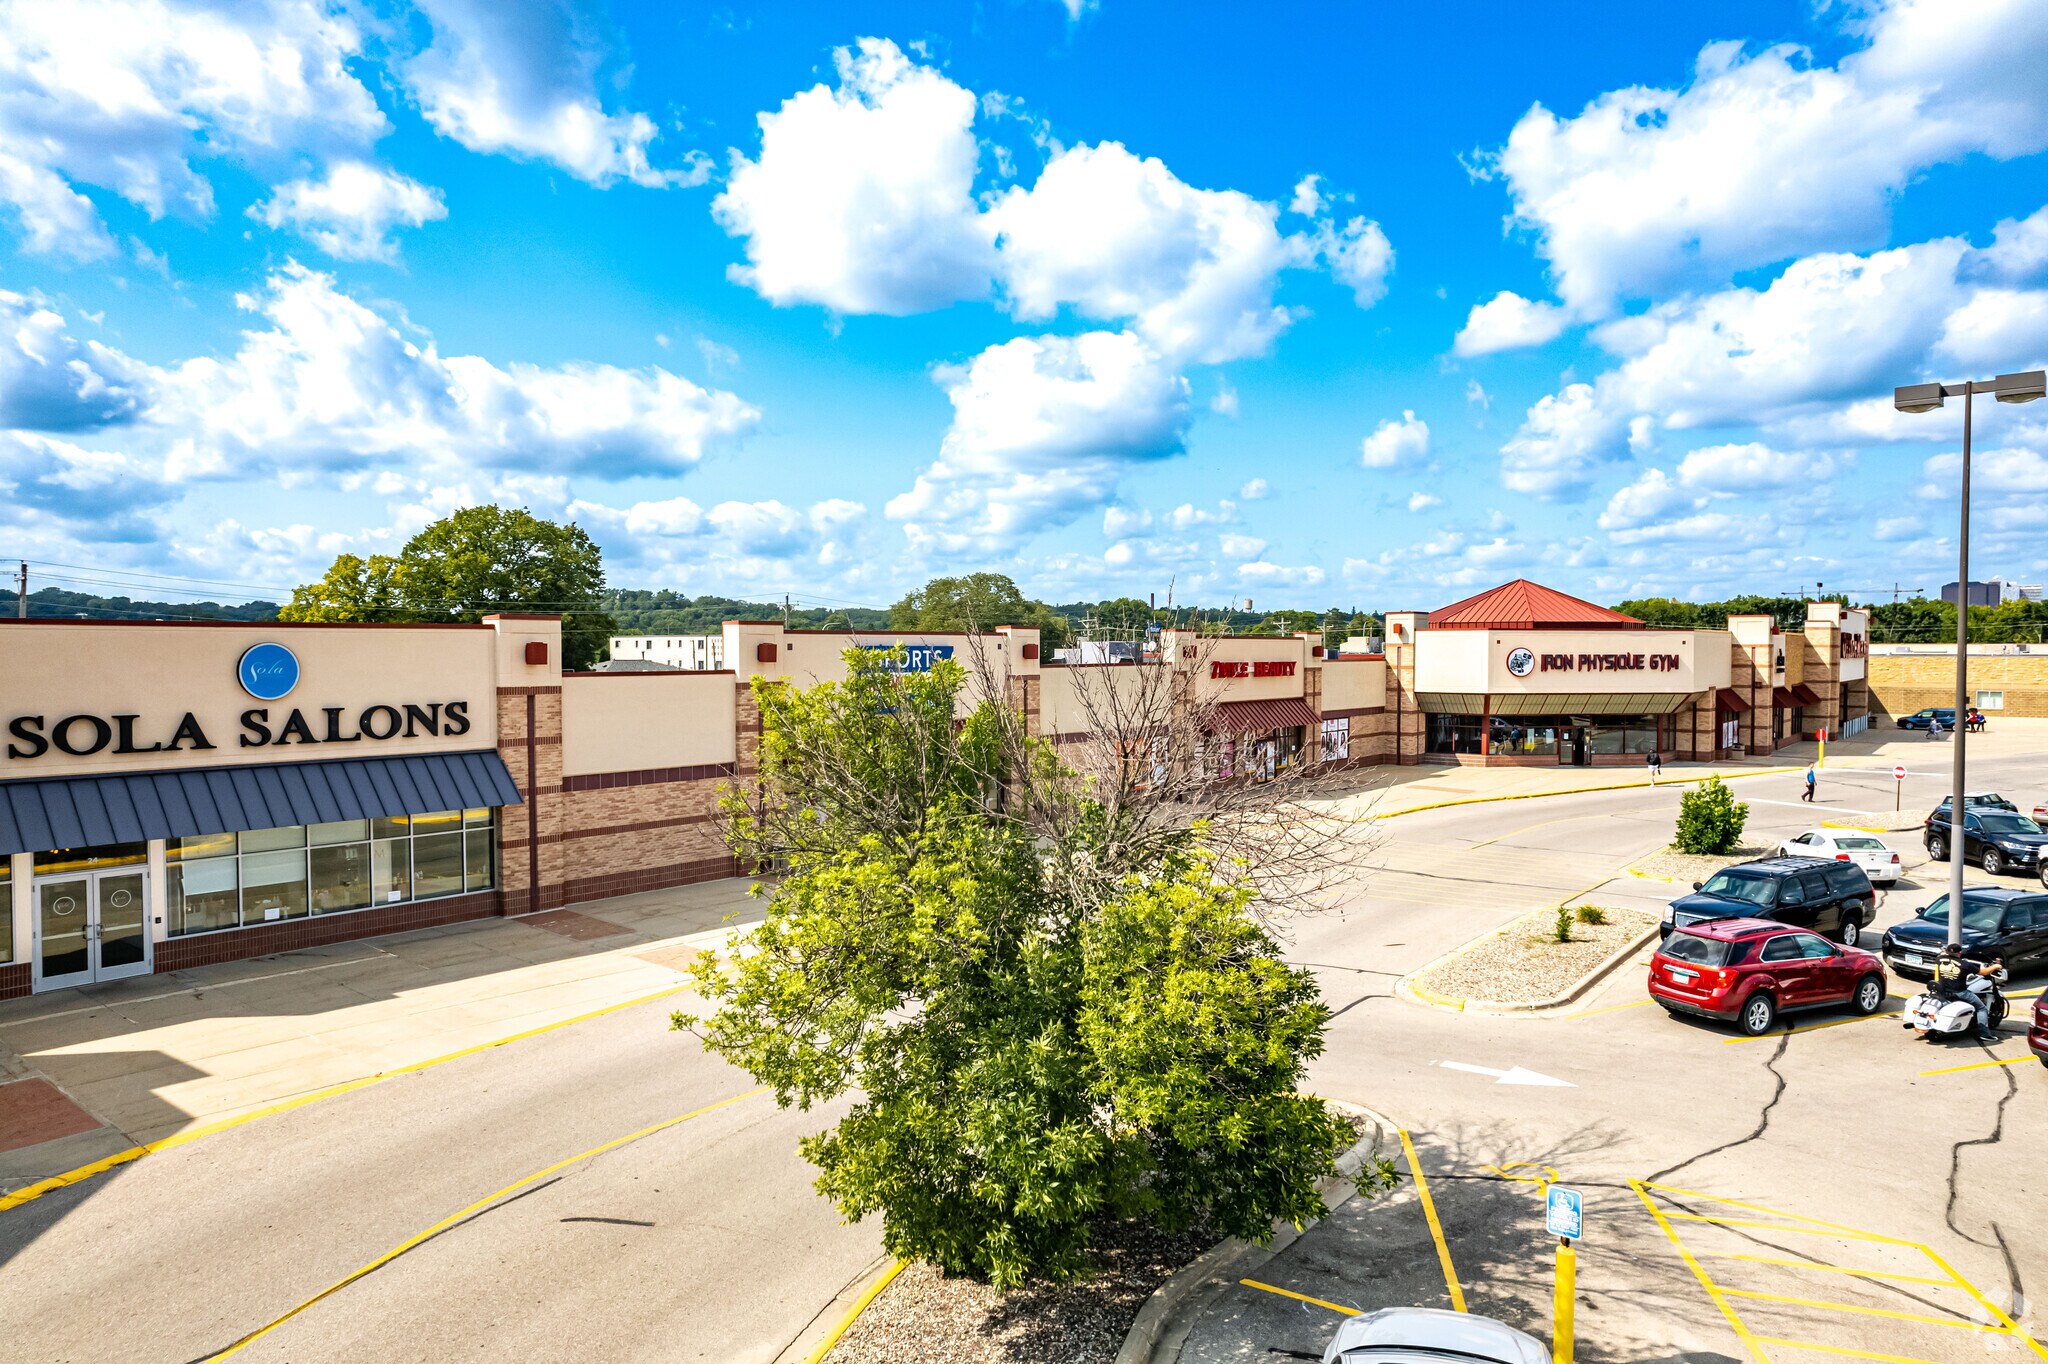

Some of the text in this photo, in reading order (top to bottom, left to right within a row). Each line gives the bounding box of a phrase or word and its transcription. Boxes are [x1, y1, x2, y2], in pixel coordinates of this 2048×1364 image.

[874, 650, 943, 668] ORTS
[1541, 652, 1680, 672] IRON PHYSIQUE GYM
[247, 659, 285, 684] Sola
[1253, 661, 1297, 677] BEAUTY
[8, 701, 471, 759] SOLA SALONS
[87, 857, 98, 865] 24
